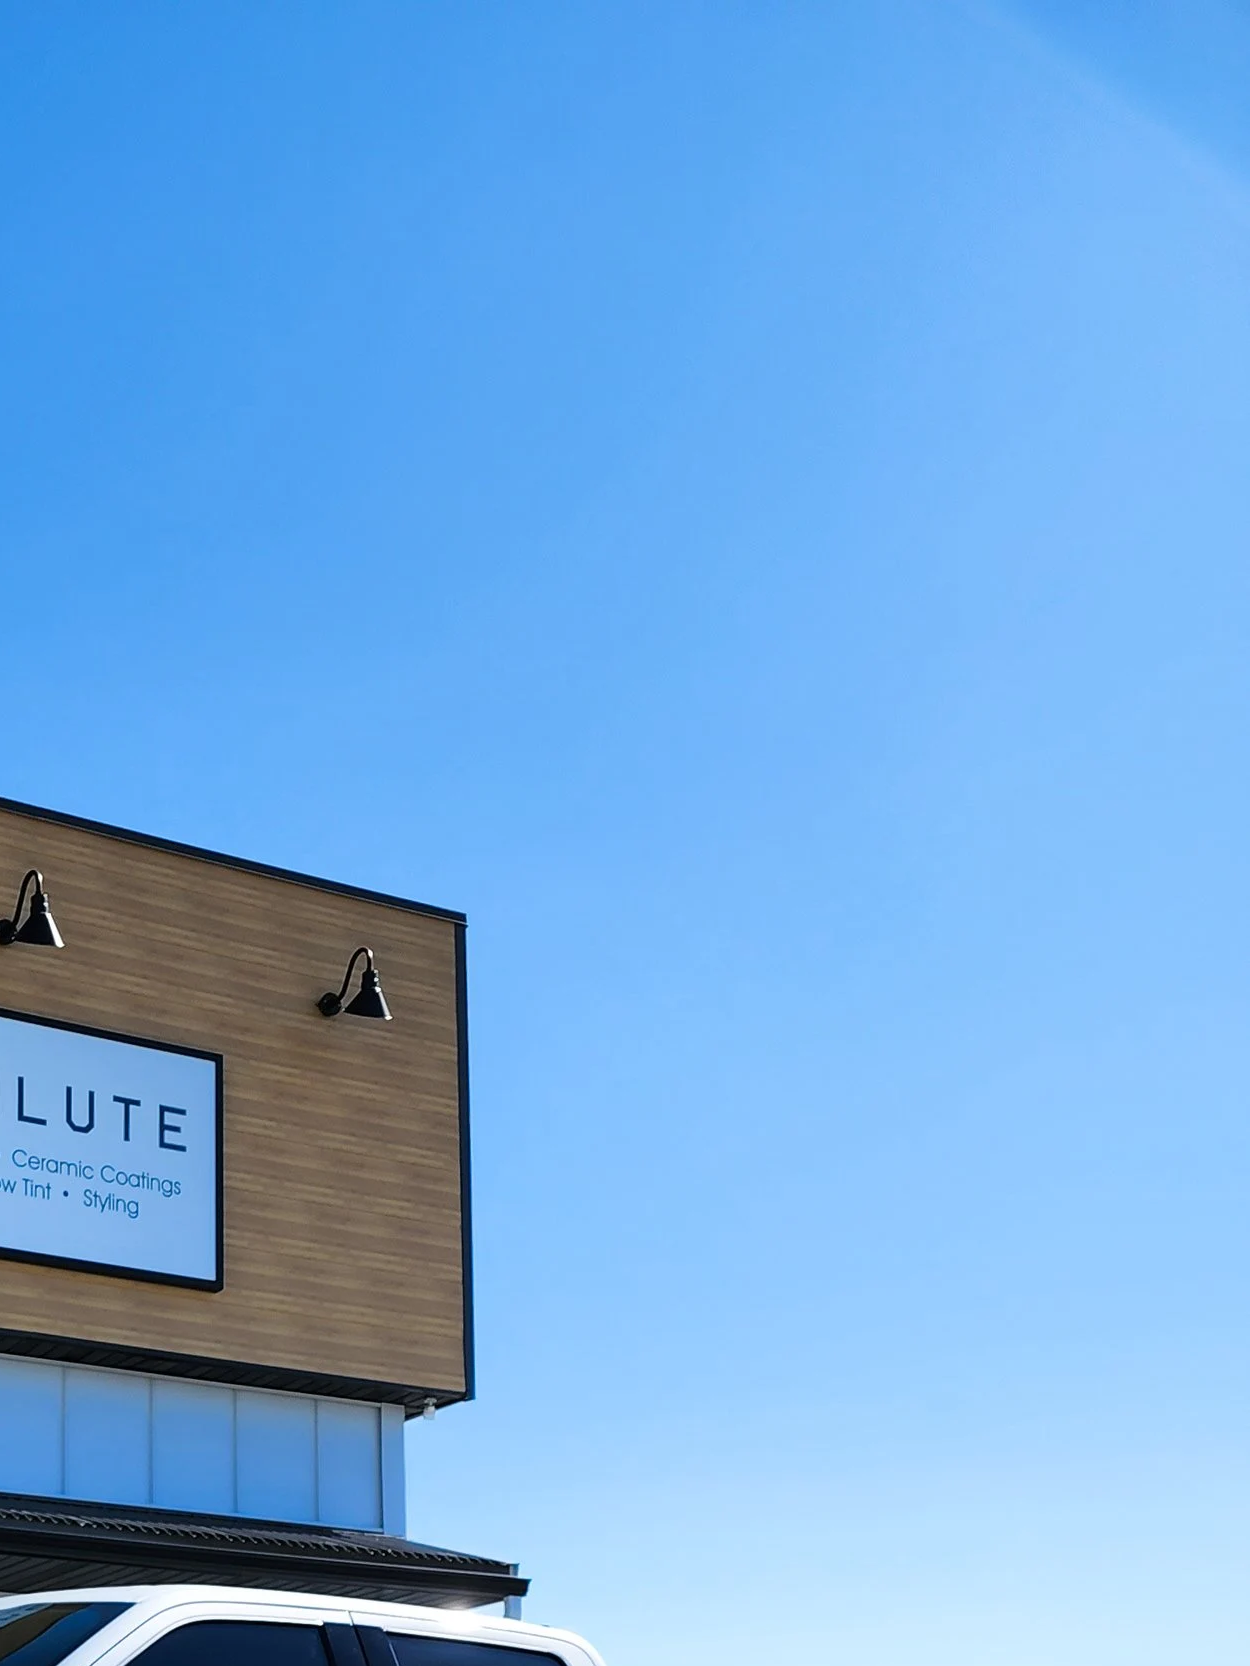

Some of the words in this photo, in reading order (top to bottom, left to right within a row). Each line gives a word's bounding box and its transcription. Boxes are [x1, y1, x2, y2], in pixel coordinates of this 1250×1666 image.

[12, 1148, 94, 1180] Ceramic
[101, 1165, 182, 1197] Coatings
[22, 1178, 52, 1201] Tint
[83, 1188, 140, 1219] Styling
